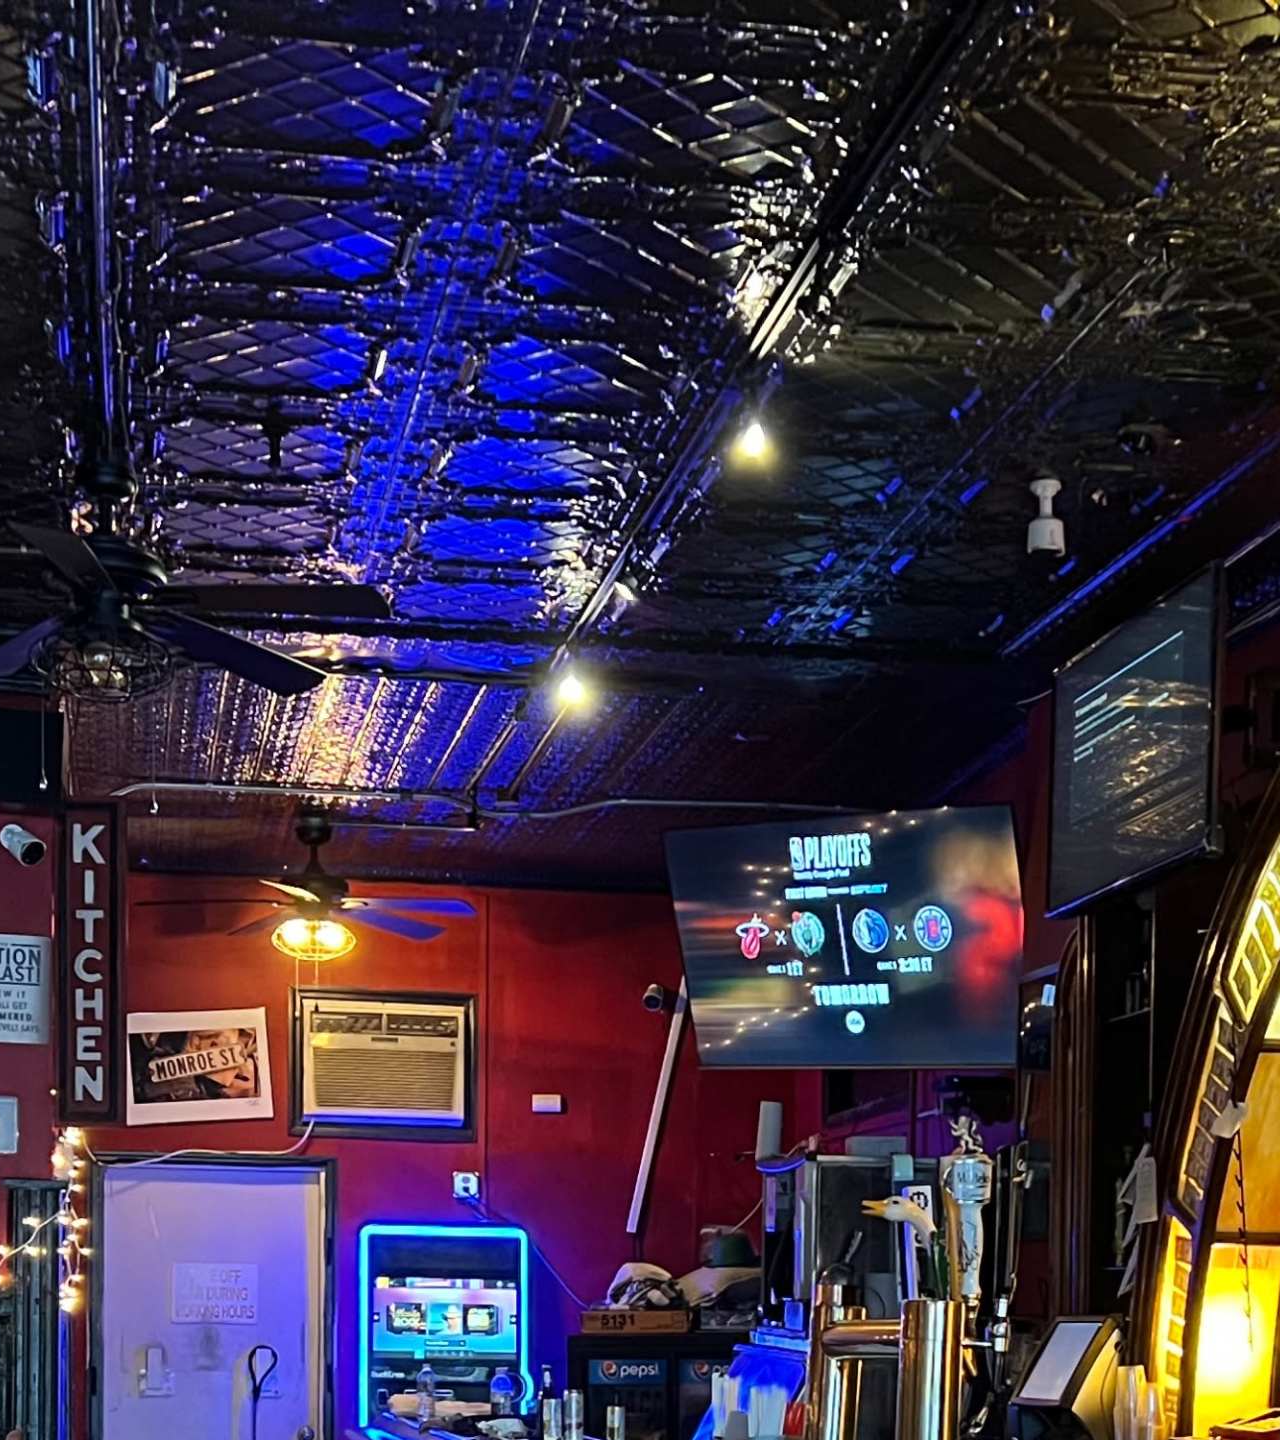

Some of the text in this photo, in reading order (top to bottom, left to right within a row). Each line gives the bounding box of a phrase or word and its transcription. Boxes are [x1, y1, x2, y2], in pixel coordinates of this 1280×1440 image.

[803, 832, 871, 869] PLAYOFFS
[72, 823, 106, 1102] KITCHEN
[16, 990, 26, 999] IT
[812, 983, 890, 1006] TOMORROW
[155, 1050, 216, 1080] MONROE
[222, 1304, 255, 1319] HOURS
[600, 1313, 635, 1326] 5131
[620, 1362, 659, 1378] pepsi
